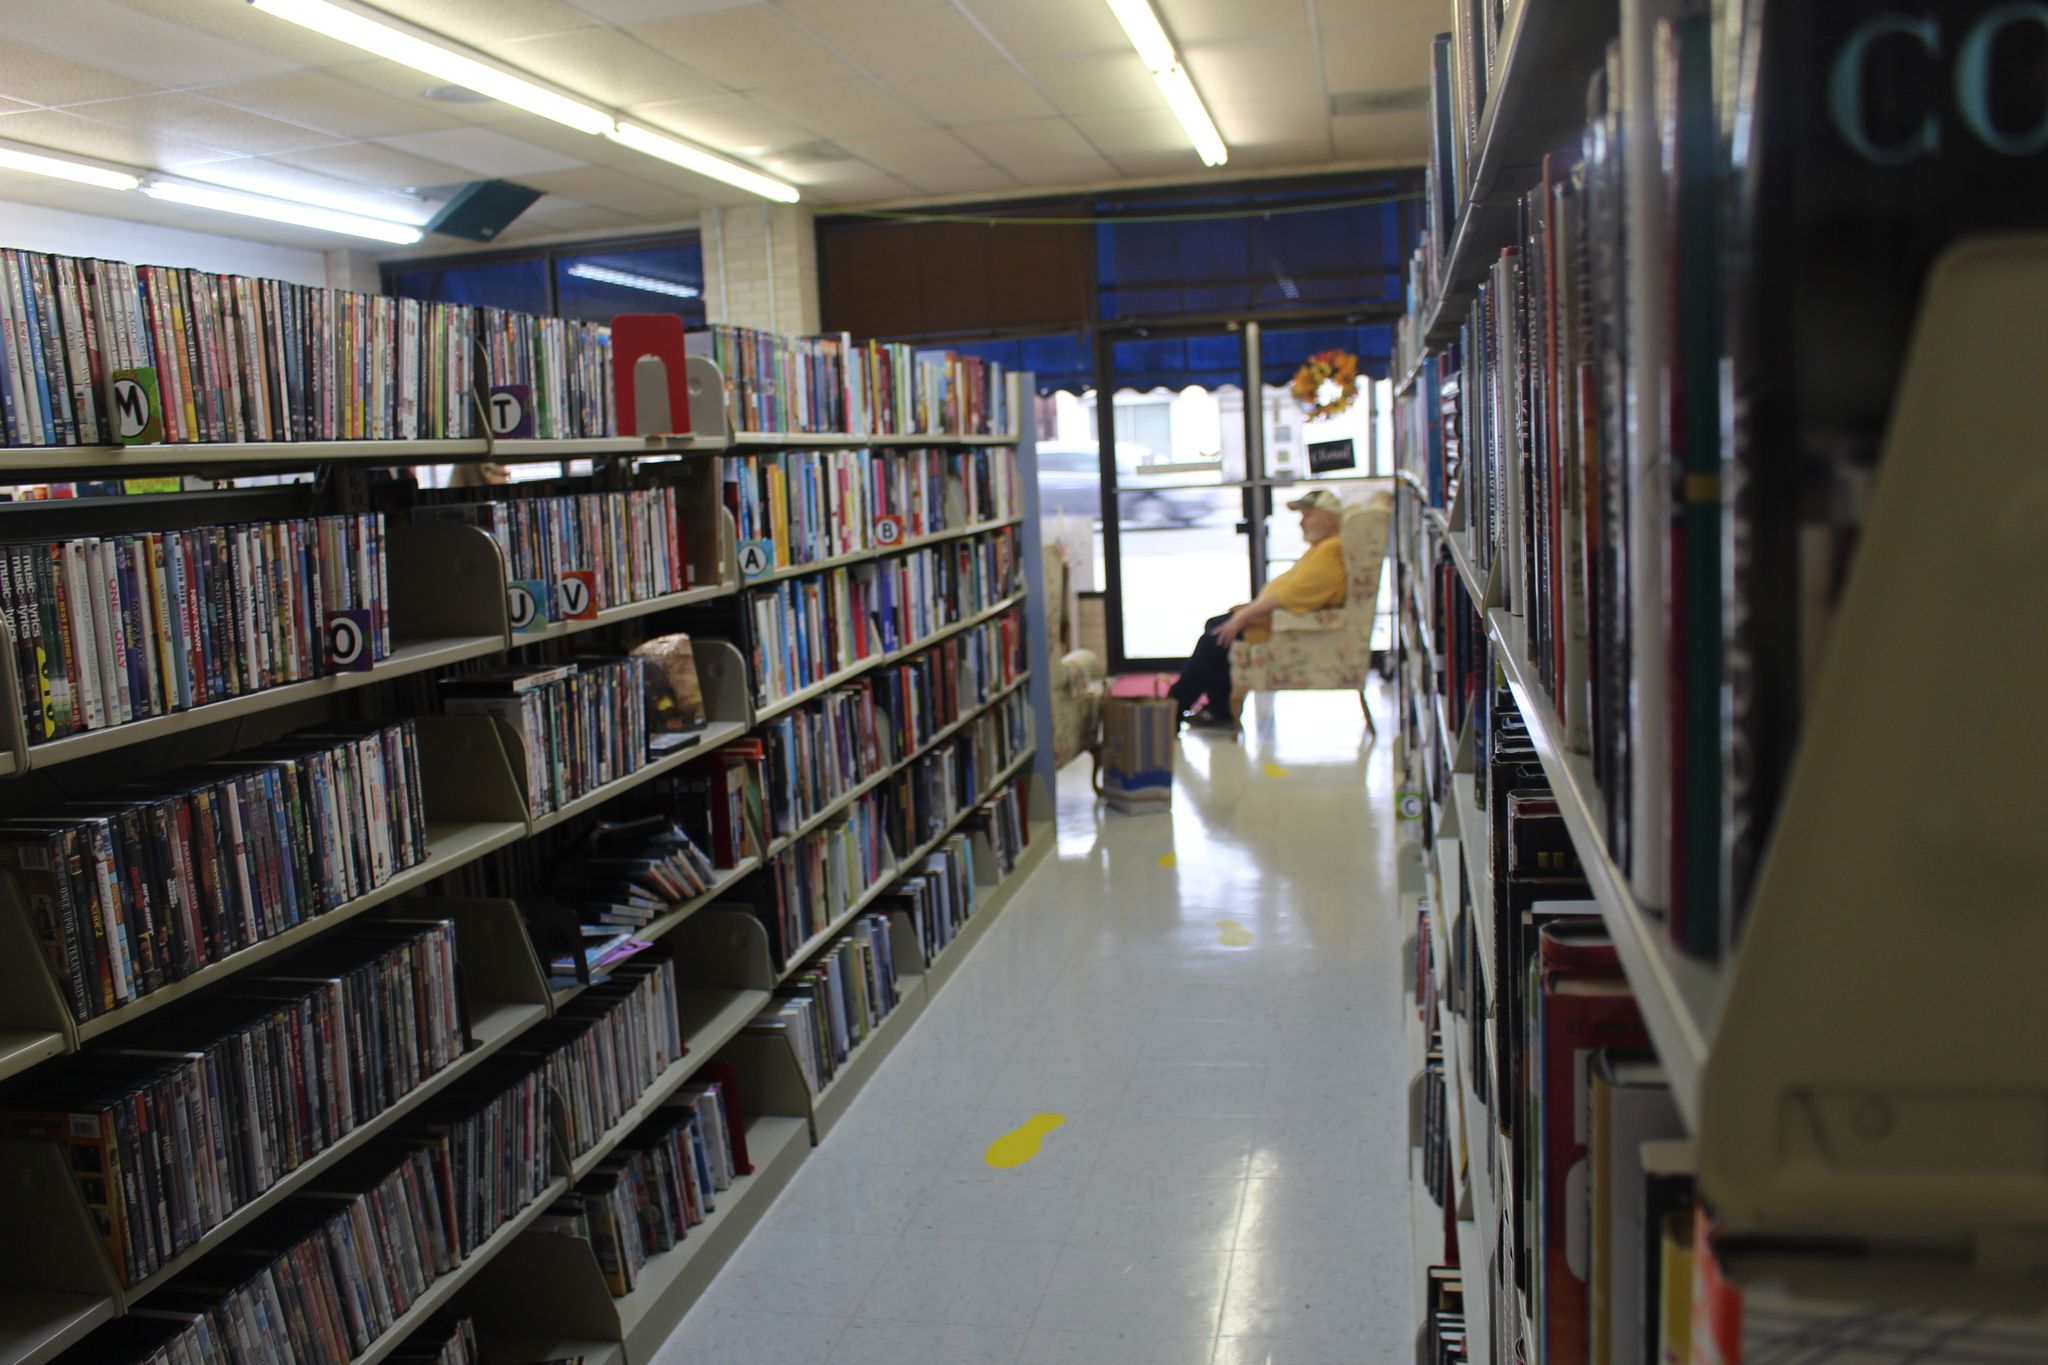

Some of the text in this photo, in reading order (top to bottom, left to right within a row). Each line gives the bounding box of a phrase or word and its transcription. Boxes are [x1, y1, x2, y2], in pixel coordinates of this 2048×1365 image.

[115, 384, 145, 425] M
[492, 399, 512, 429] T
[882, 522, 893, 539] B
[12, 556, 26, 595] music
[22, 555, 36, 594] music
[745, 549, 760, 569] A
[0, 560, 12, 599] music
[190, 588, 198, 615] NEW
[510, 593, 526, 623] U
[562, 584, 582, 612] V
[16, 604, 31, 639] lyrics
[28, 603, 41, 637] lyrics
[109, 579, 120, 613] ONE
[115, 630, 126, 668] ONLY
[199, 596, 209, 637] NEXT
[193, 619, 202, 652] TOWN
[336, 623, 356, 659] O
[60, 887, 69, 909] ONCE
[63, 911, 73, 934] UPON
[69, 946, 80, 973] TEXAS
